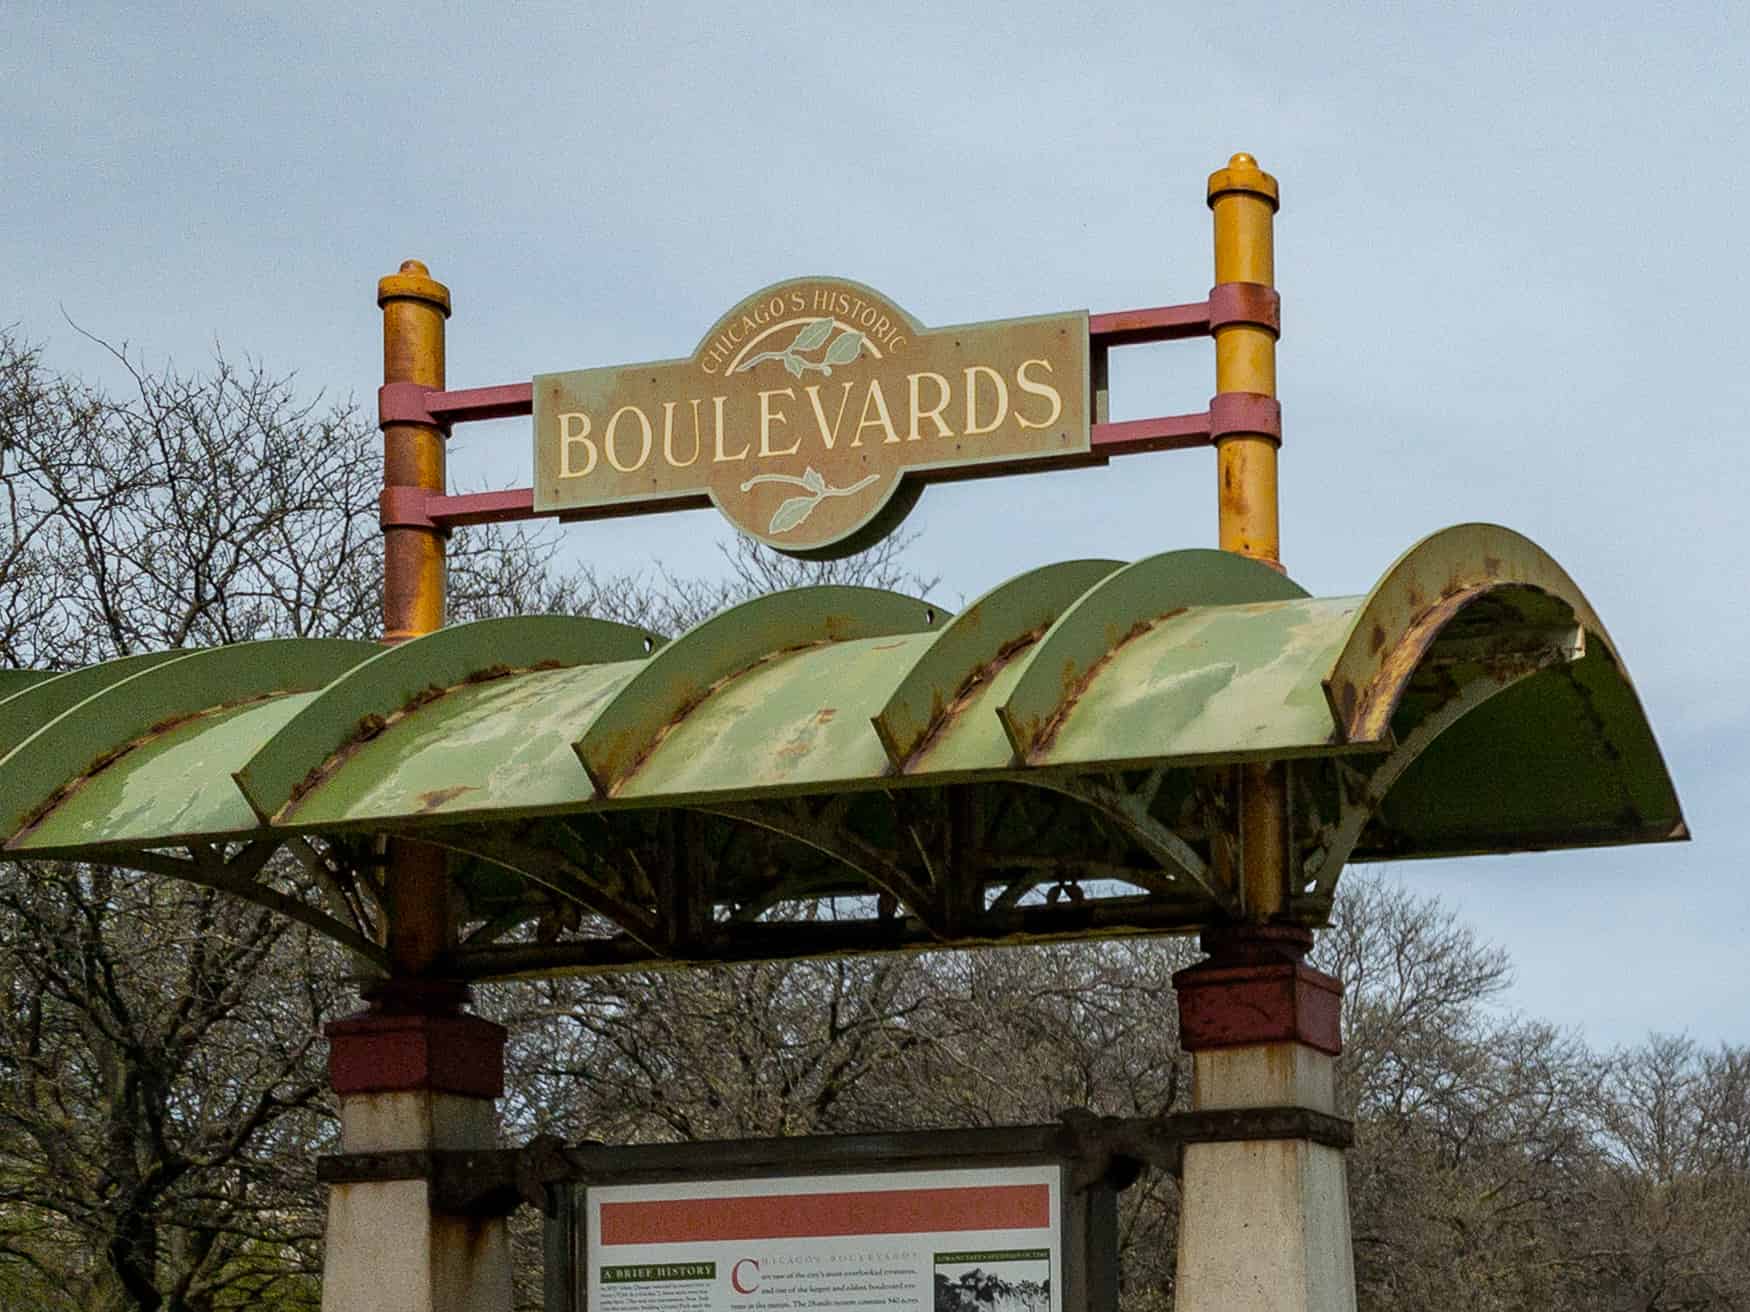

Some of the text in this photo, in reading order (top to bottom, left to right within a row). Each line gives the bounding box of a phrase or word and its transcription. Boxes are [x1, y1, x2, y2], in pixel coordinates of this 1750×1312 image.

[702, 289, 909, 376] CHICAGO'S HISTORIC
[556, 358, 1064, 480] BOULEVARDS
[616, 1269, 651, 1279] BRIEF
[657, 1265, 713, 1277] HISTORY
